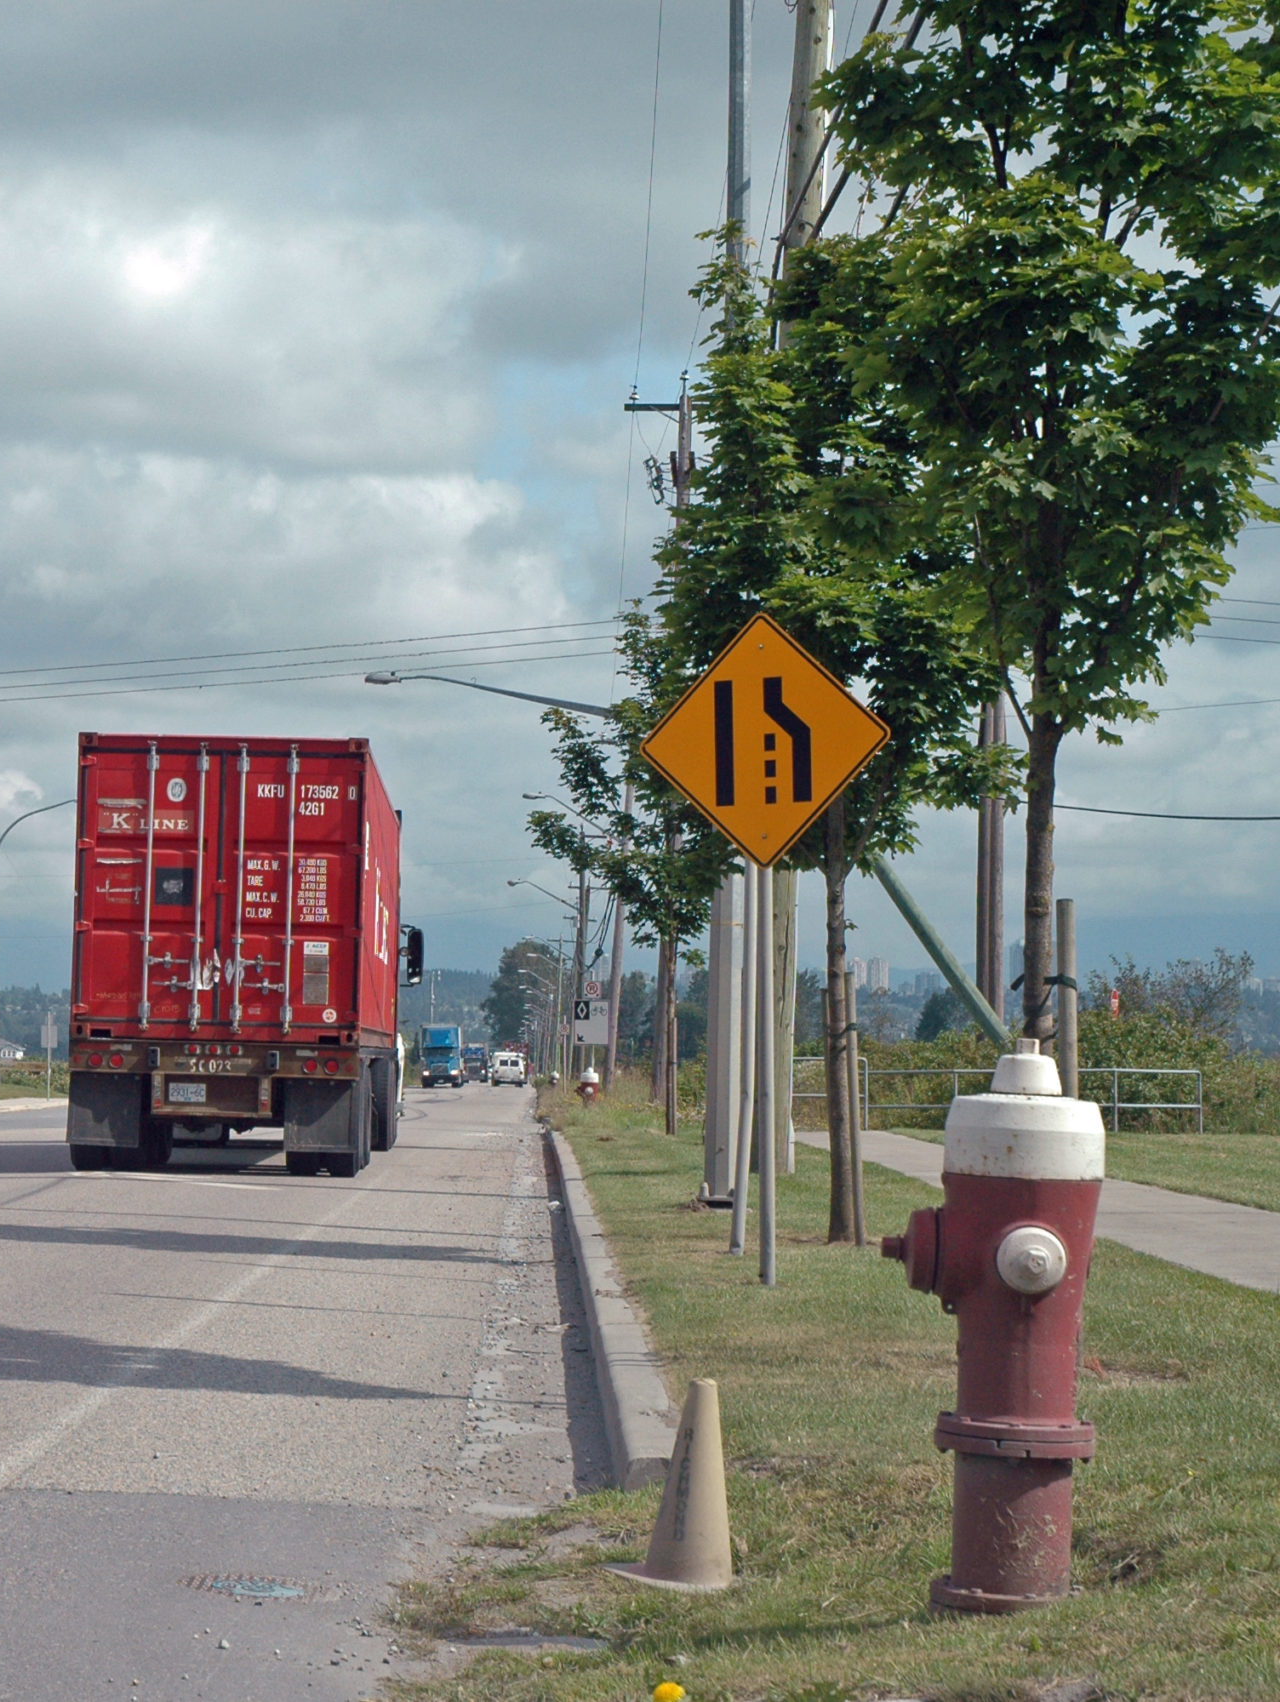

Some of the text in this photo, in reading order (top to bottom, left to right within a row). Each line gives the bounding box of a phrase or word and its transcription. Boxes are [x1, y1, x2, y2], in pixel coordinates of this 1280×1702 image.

[257, 784, 285, 798] KKFU
[298, 801, 325, 816] 42G1
[140, 818, 189, 830] LINE
